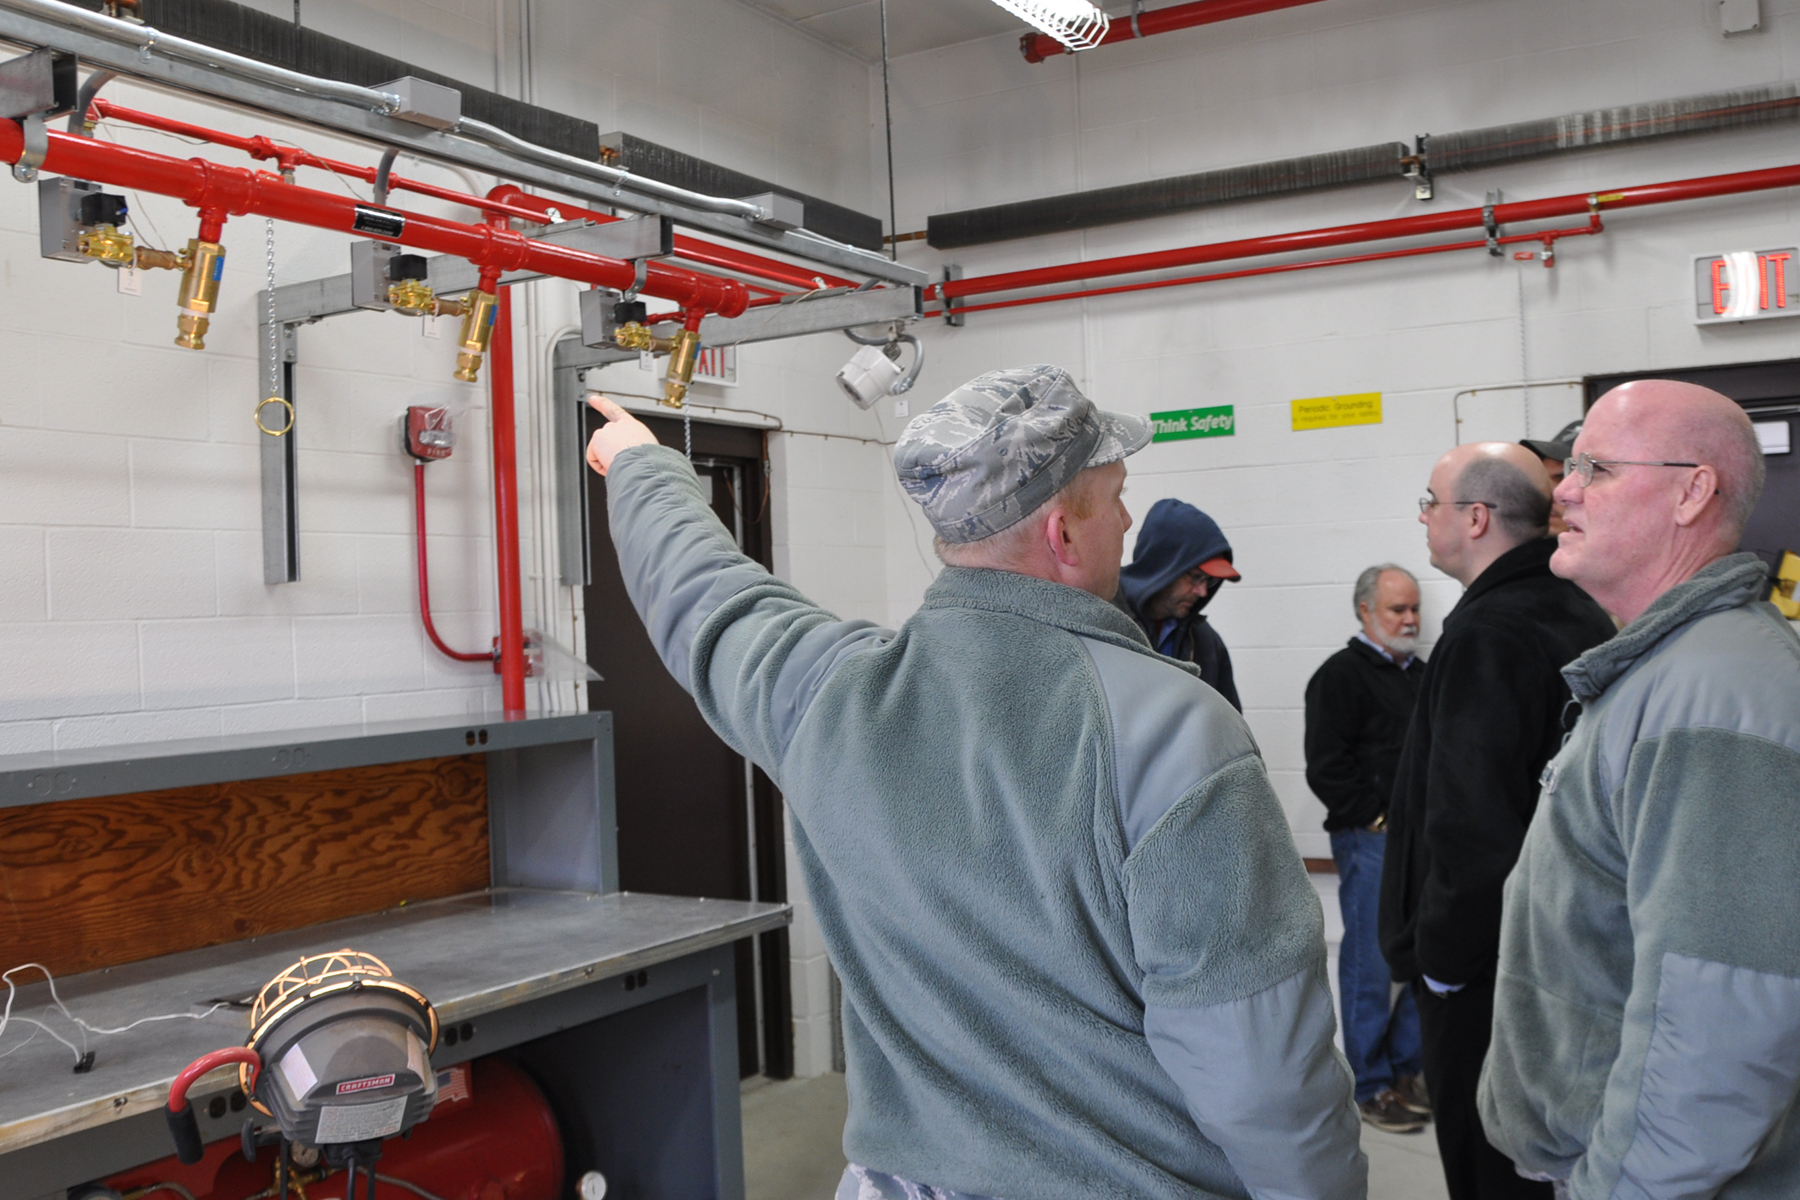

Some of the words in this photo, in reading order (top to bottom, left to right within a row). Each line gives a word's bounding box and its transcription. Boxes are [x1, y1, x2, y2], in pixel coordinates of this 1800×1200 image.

[1711, 253, 1791, 314] EIT
[1152, 417, 1188, 434] Think
[1190, 414, 1233, 432] Safety
[427, 448, 445, 457] FIRE
[340, 1077, 391, 1092] CRAFTSMAN
